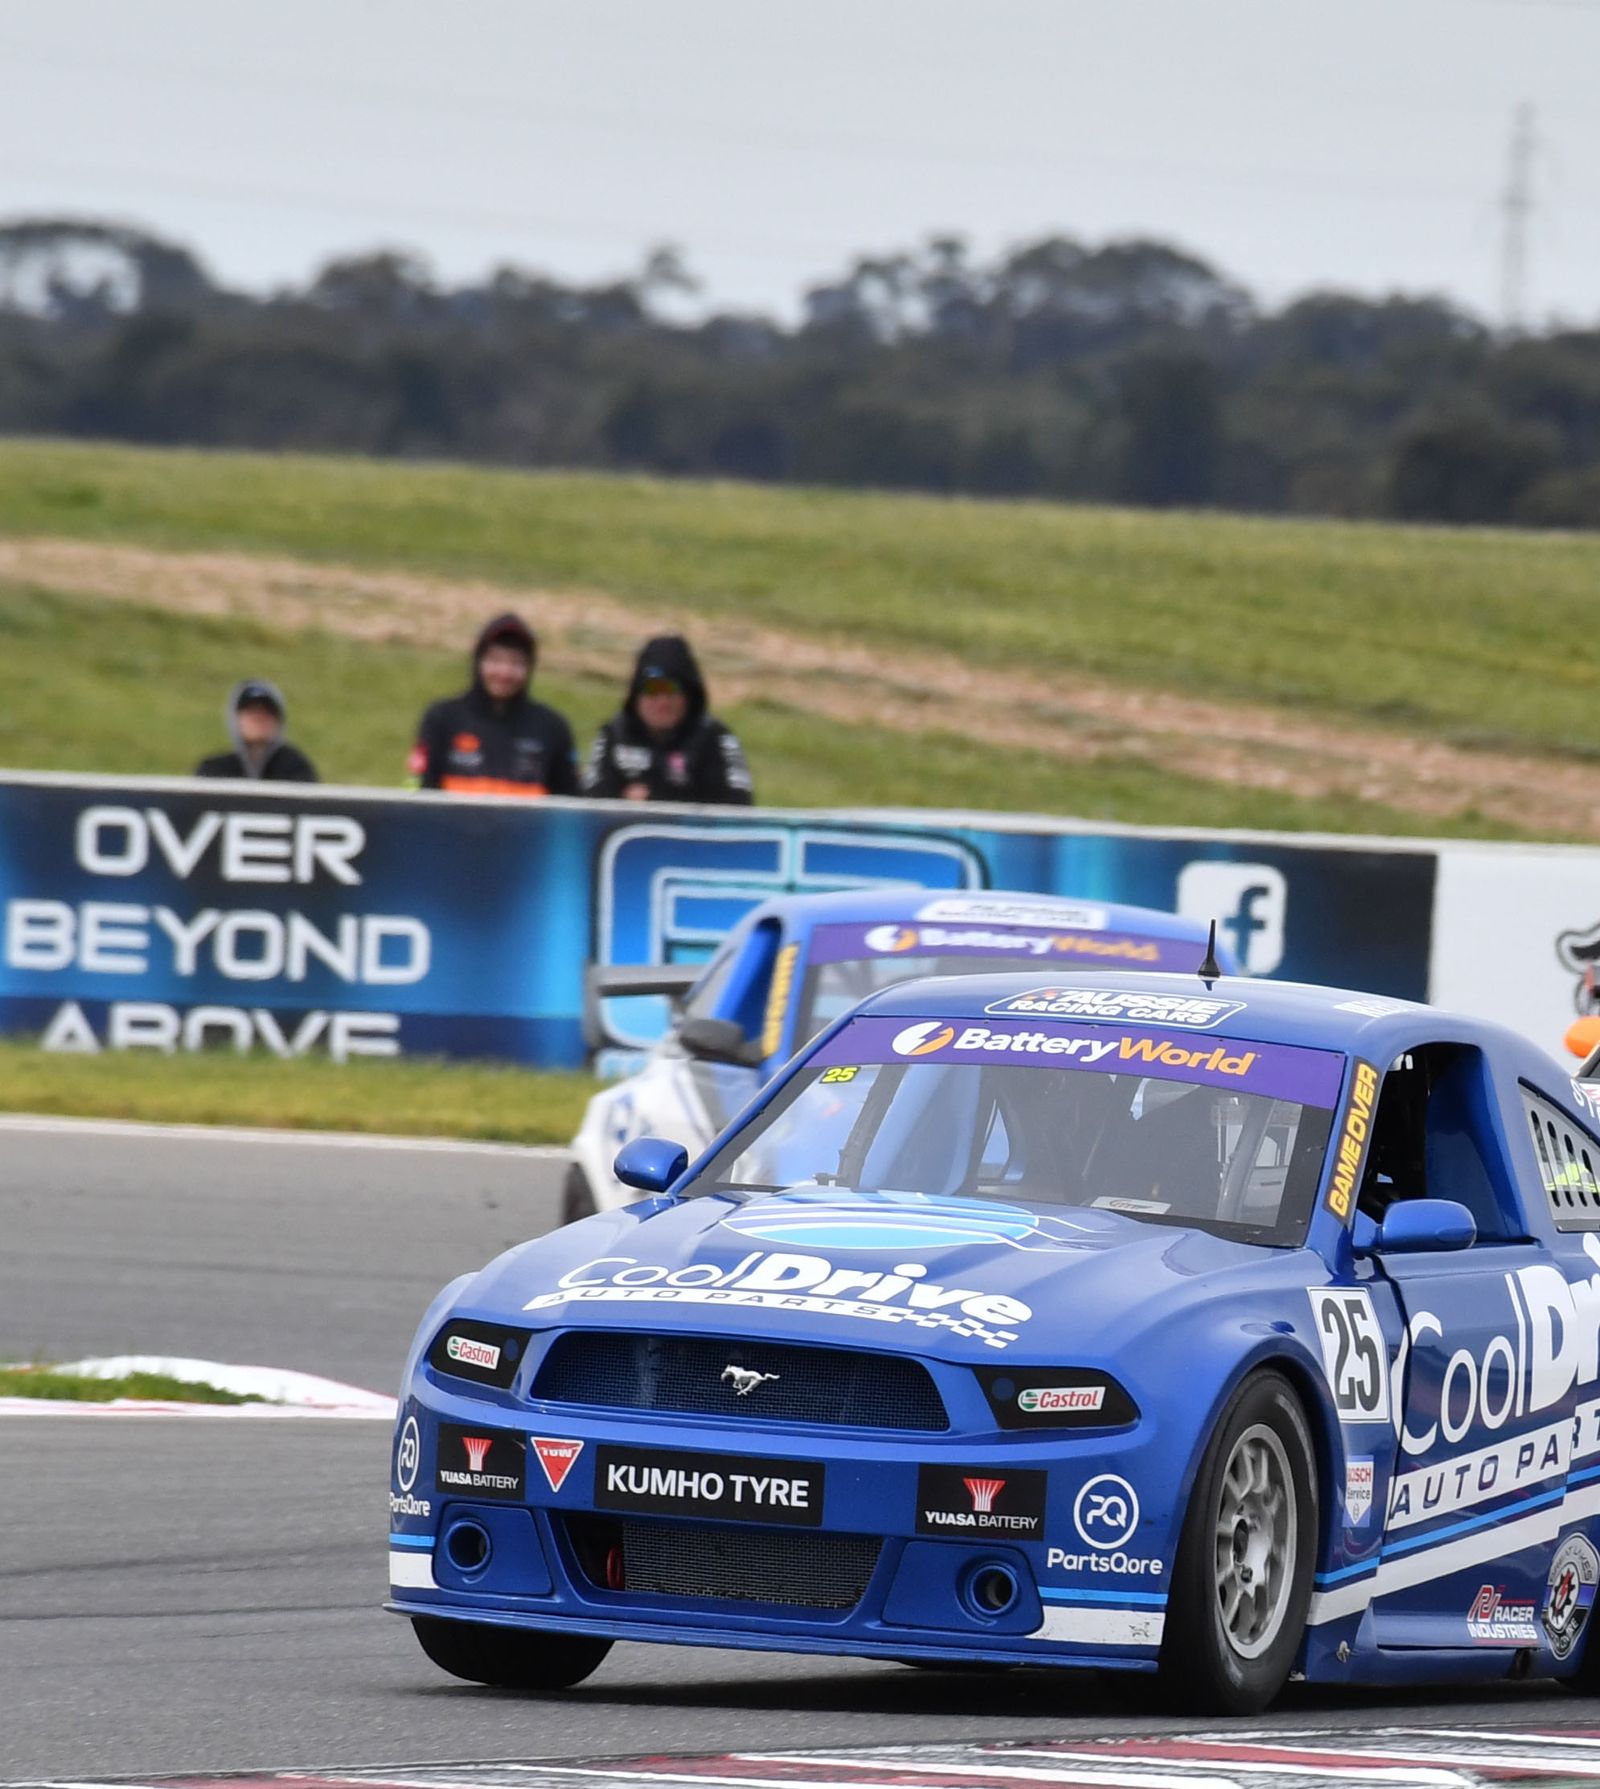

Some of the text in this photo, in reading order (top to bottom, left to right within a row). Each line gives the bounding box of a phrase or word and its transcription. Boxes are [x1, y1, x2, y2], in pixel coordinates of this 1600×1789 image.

[76, 806, 366, 885] OVER
[6, 900, 431, 986] BEYOND
[1007, 999, 1211, 1024] RACING CARS
[1058, 989, 1230, 1016] AUSSIE
[824, 1066, 858, 1084] 25
[558, 1251, 1032, 1325] CoolDrive
[546, 1289, 882, 1315] AUTO PARTS
[459, 1341, 498, 1366] Castrol
[1322, 1296, 1383, 1415] 25
[1039, 1390, 1098, 1409] Castrol
[440, 1470, 519, 1490] YUASA BATTERY
[607, 1463, 810, 1507] KUMHO TYRE
[1390, 1454, 1499, 1521] AUTO
[925, 1510, 1038, 1530] YUASA BATTERY
[1047, 1547, 1163, 1575] PartsQore
[1494, 1606, 1535, 1622] RACER
[1467, 1623, 1538, 1639] INDUSTRIES
